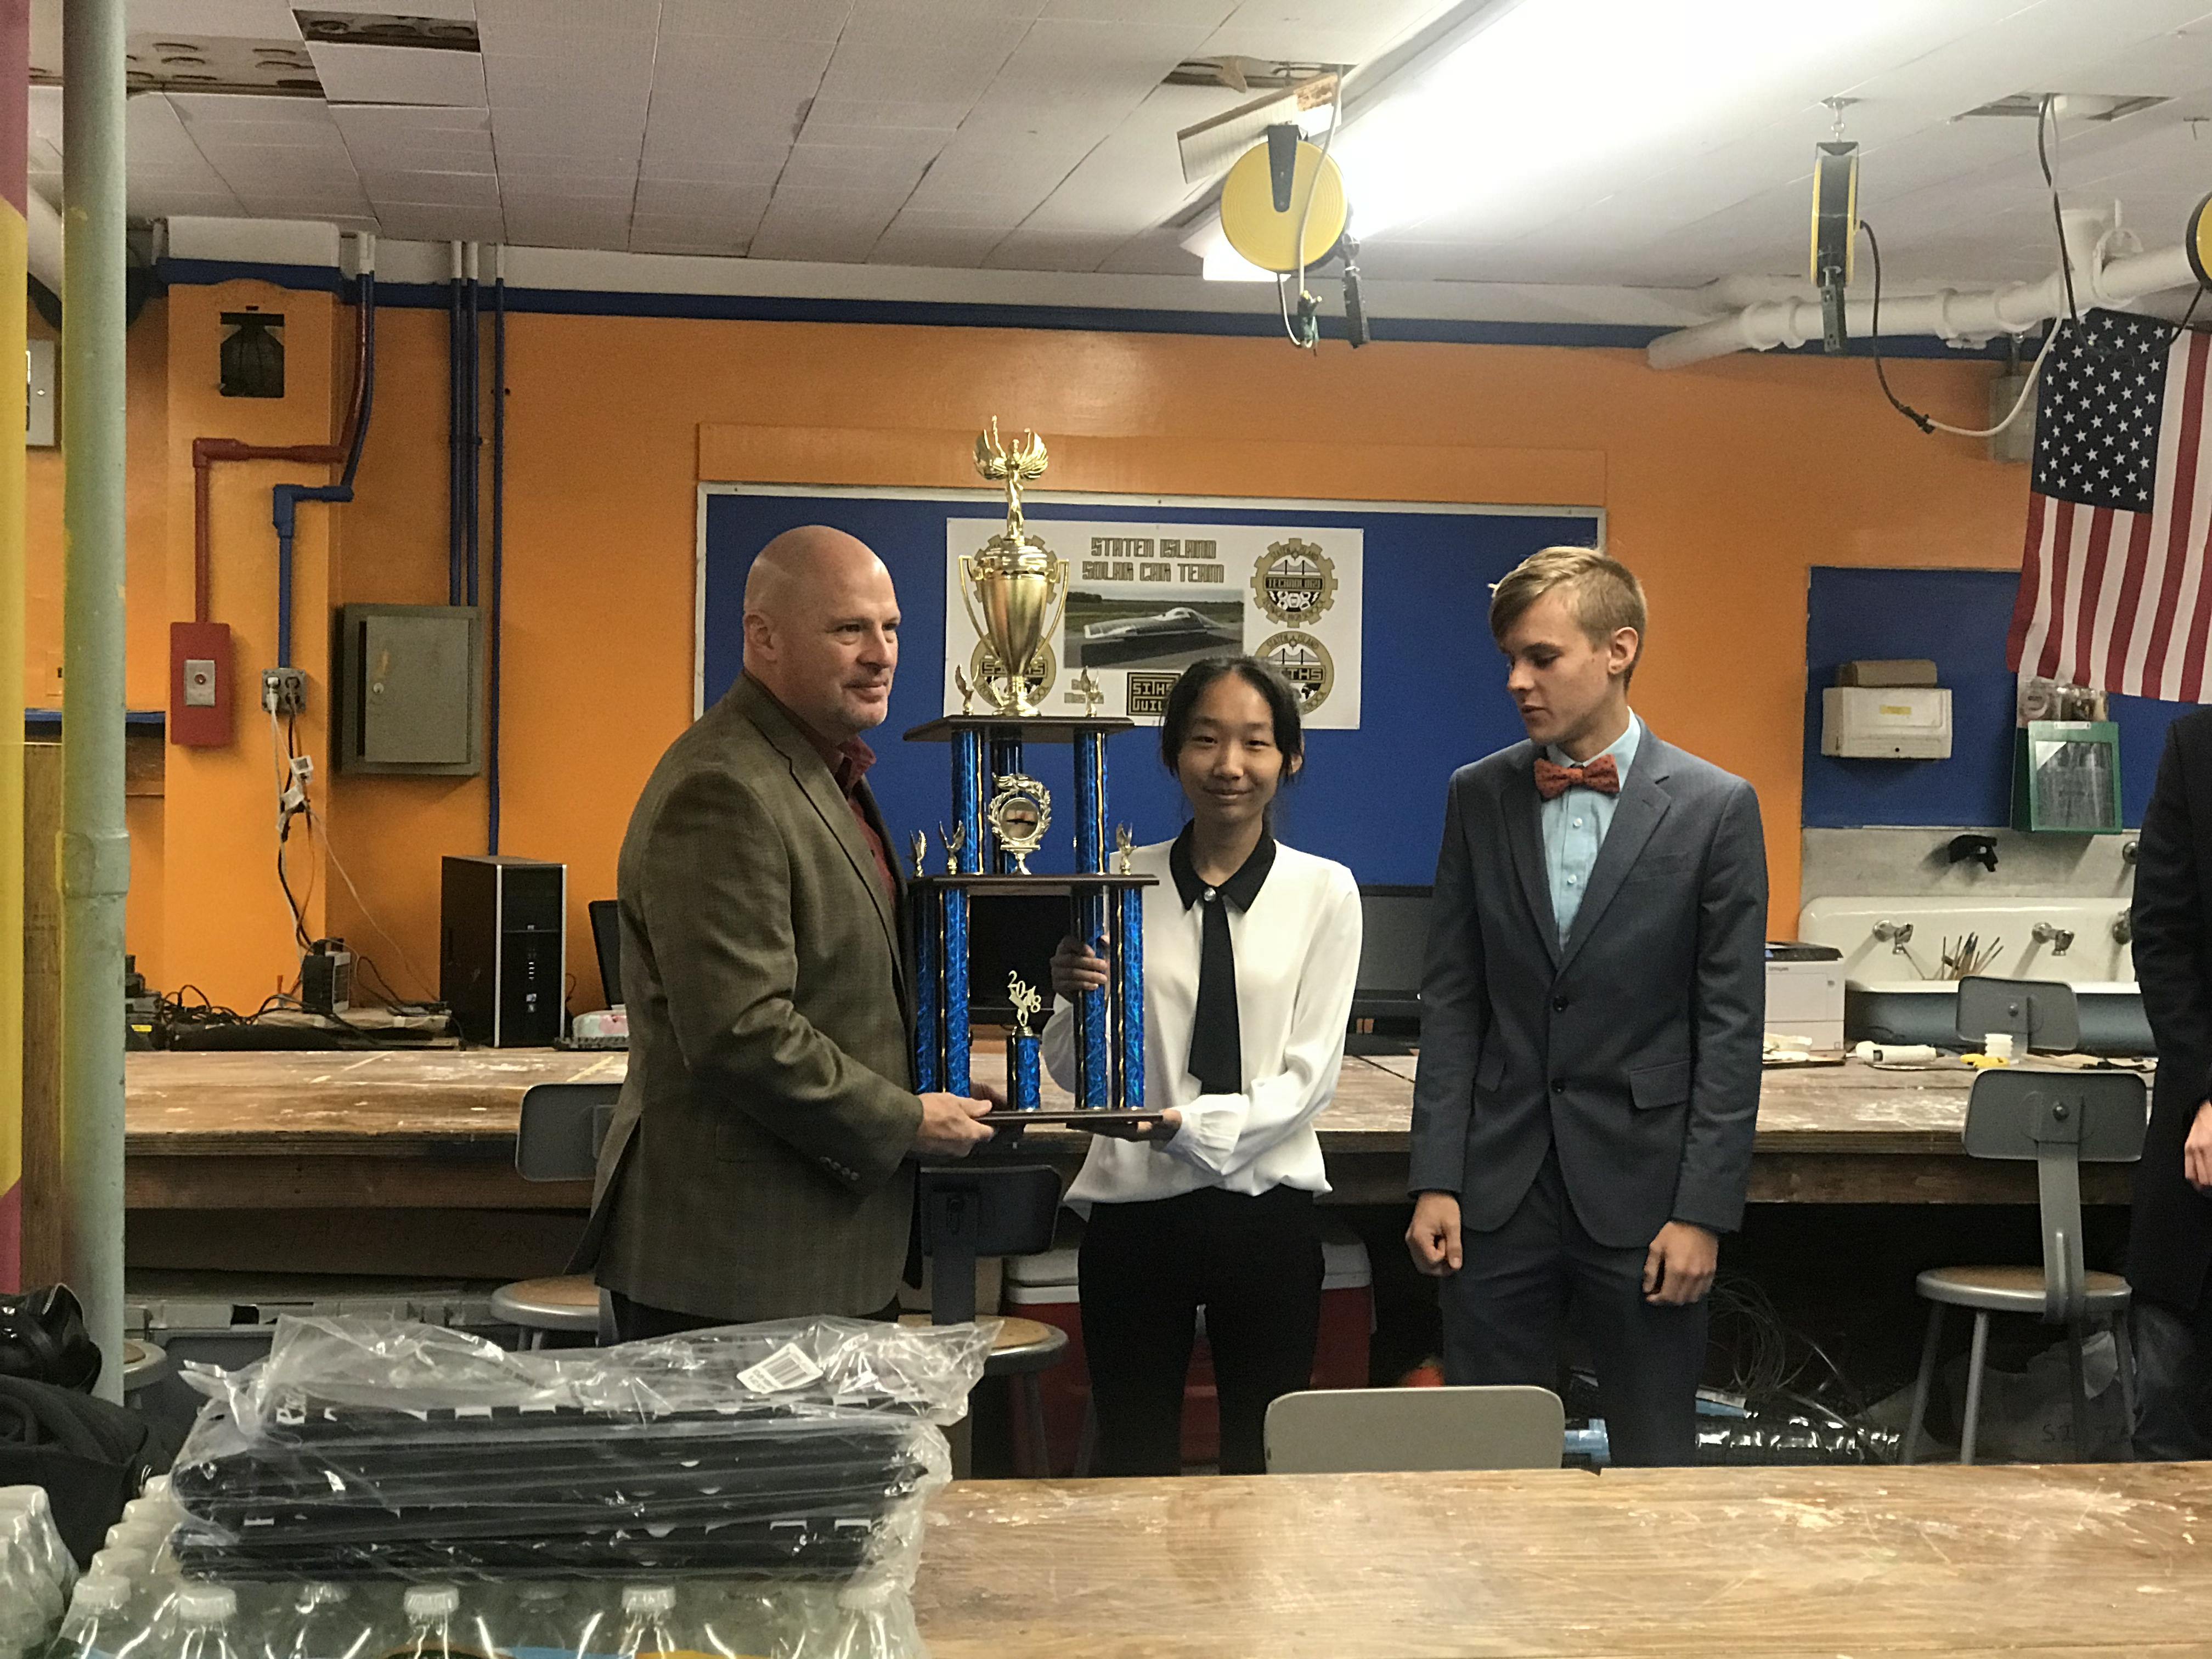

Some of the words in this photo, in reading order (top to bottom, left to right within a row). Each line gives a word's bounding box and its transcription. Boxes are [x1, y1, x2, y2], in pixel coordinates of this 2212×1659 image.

[1091, 537, 1154, 557] STATEN
[1160, 539, 1216, 559] ISLAND
[1082, 561, 1134, 580] SOLAR
[1139, 562, 1171, 582] CAR
[1177, 563, 1224, 583] TEAM
[1286, 668, 1322, 680] THS
[1007, 970, 1042, 1013] 2018
